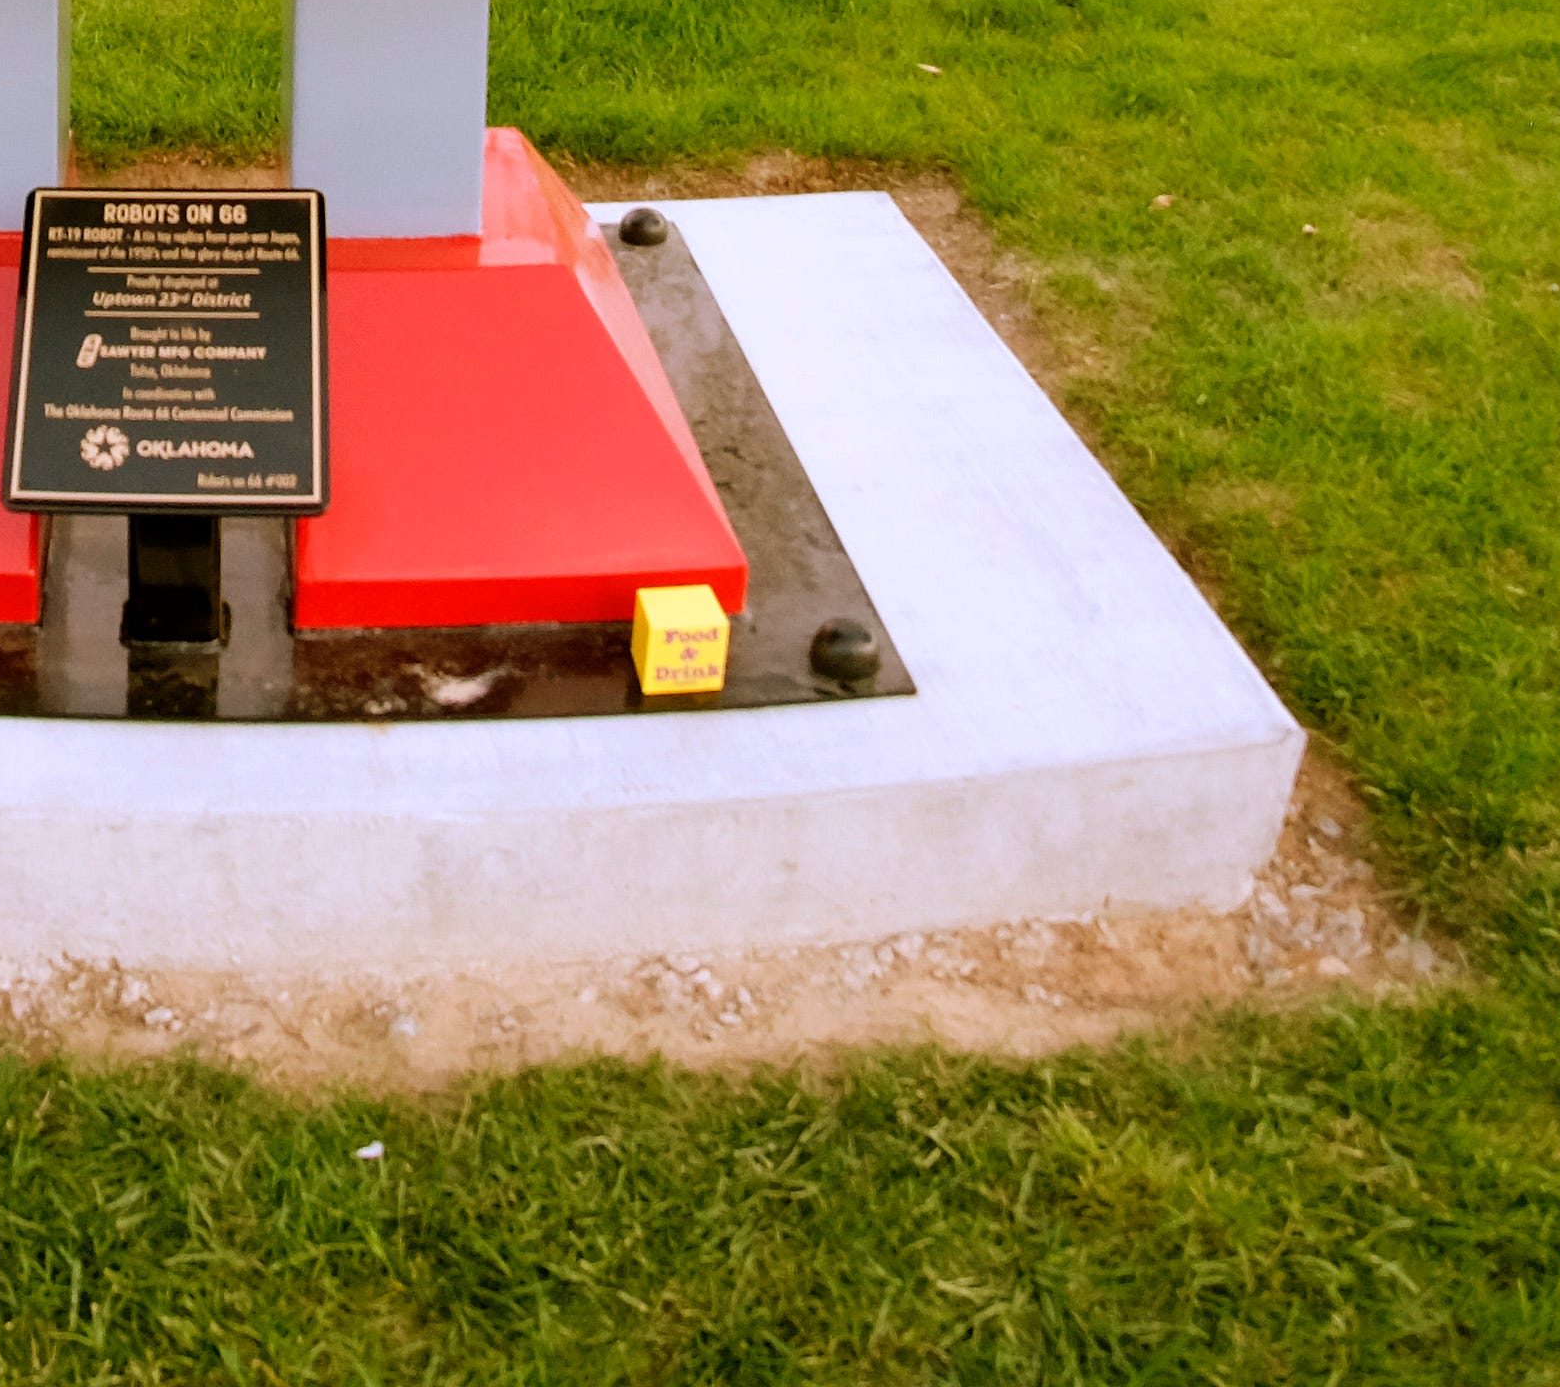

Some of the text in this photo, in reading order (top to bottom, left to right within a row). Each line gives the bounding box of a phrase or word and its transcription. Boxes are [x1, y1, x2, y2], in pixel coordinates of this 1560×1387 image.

[103, 203, 248, 225] ROBOTS ON 66
[83, 227, 124, 243] ROBOT
[92, 290, 157, 309] Uptown
[191, 292, 252, 308] District
[193, 346, 267, 360] COMPANY
[44, 403, 65, 419] The
[66, 403, 121, 420] Oklahoma
[122, 405, 154, 420] Route
[136, 439, 255, 460] OKLAHOMA
[664, 628, 719, 644] Food
[680, 647, 699, 661] &
[655, 664, 720, 682] Drink
